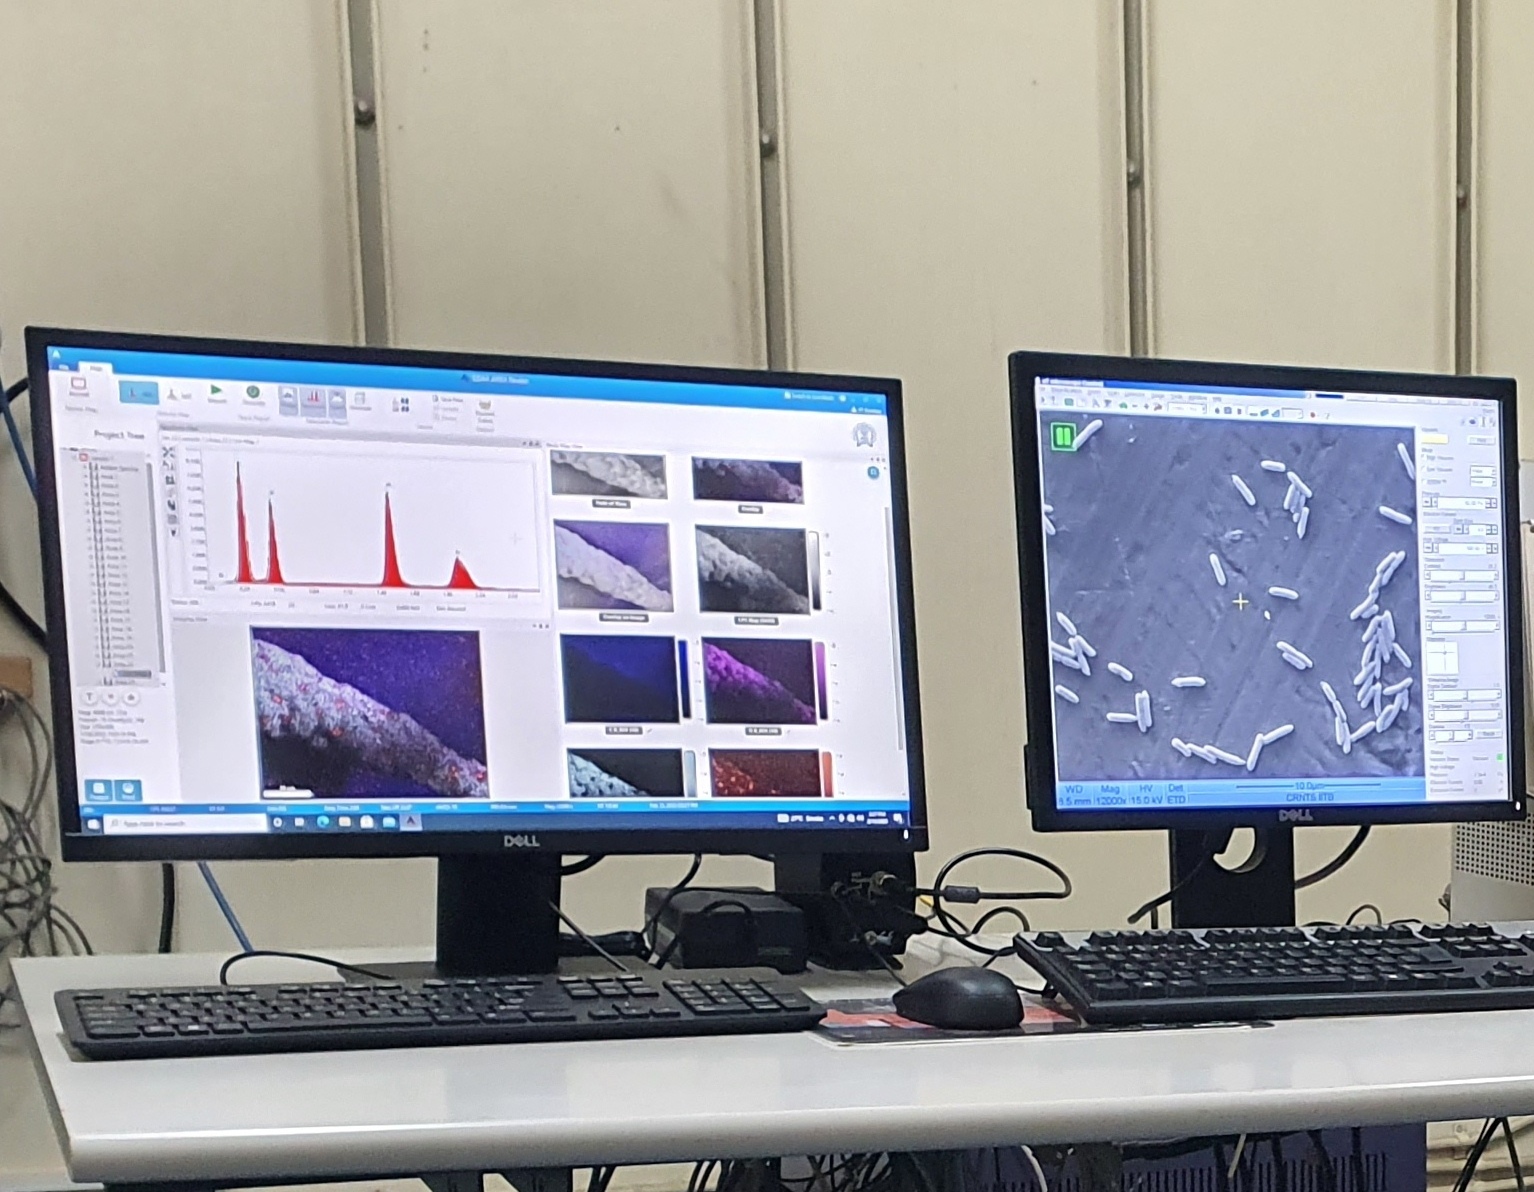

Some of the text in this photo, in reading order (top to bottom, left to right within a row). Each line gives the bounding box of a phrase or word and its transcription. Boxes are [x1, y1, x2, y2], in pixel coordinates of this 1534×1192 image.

[1065, 785, 1083, 794] WD
[1100, 784, 1120, 795] Mag
[1139, 784, 1153, 793] HV
[1074, 798, 1091, 806] mm
[1096, 797, 1126, 806] 12000x
[1152, 796, 1163, 804] kV
[1167, 795, 1186, 804] ETD
[1278, 808, 1314, 822] DELL
[503, 834, 541, 848] DELL
